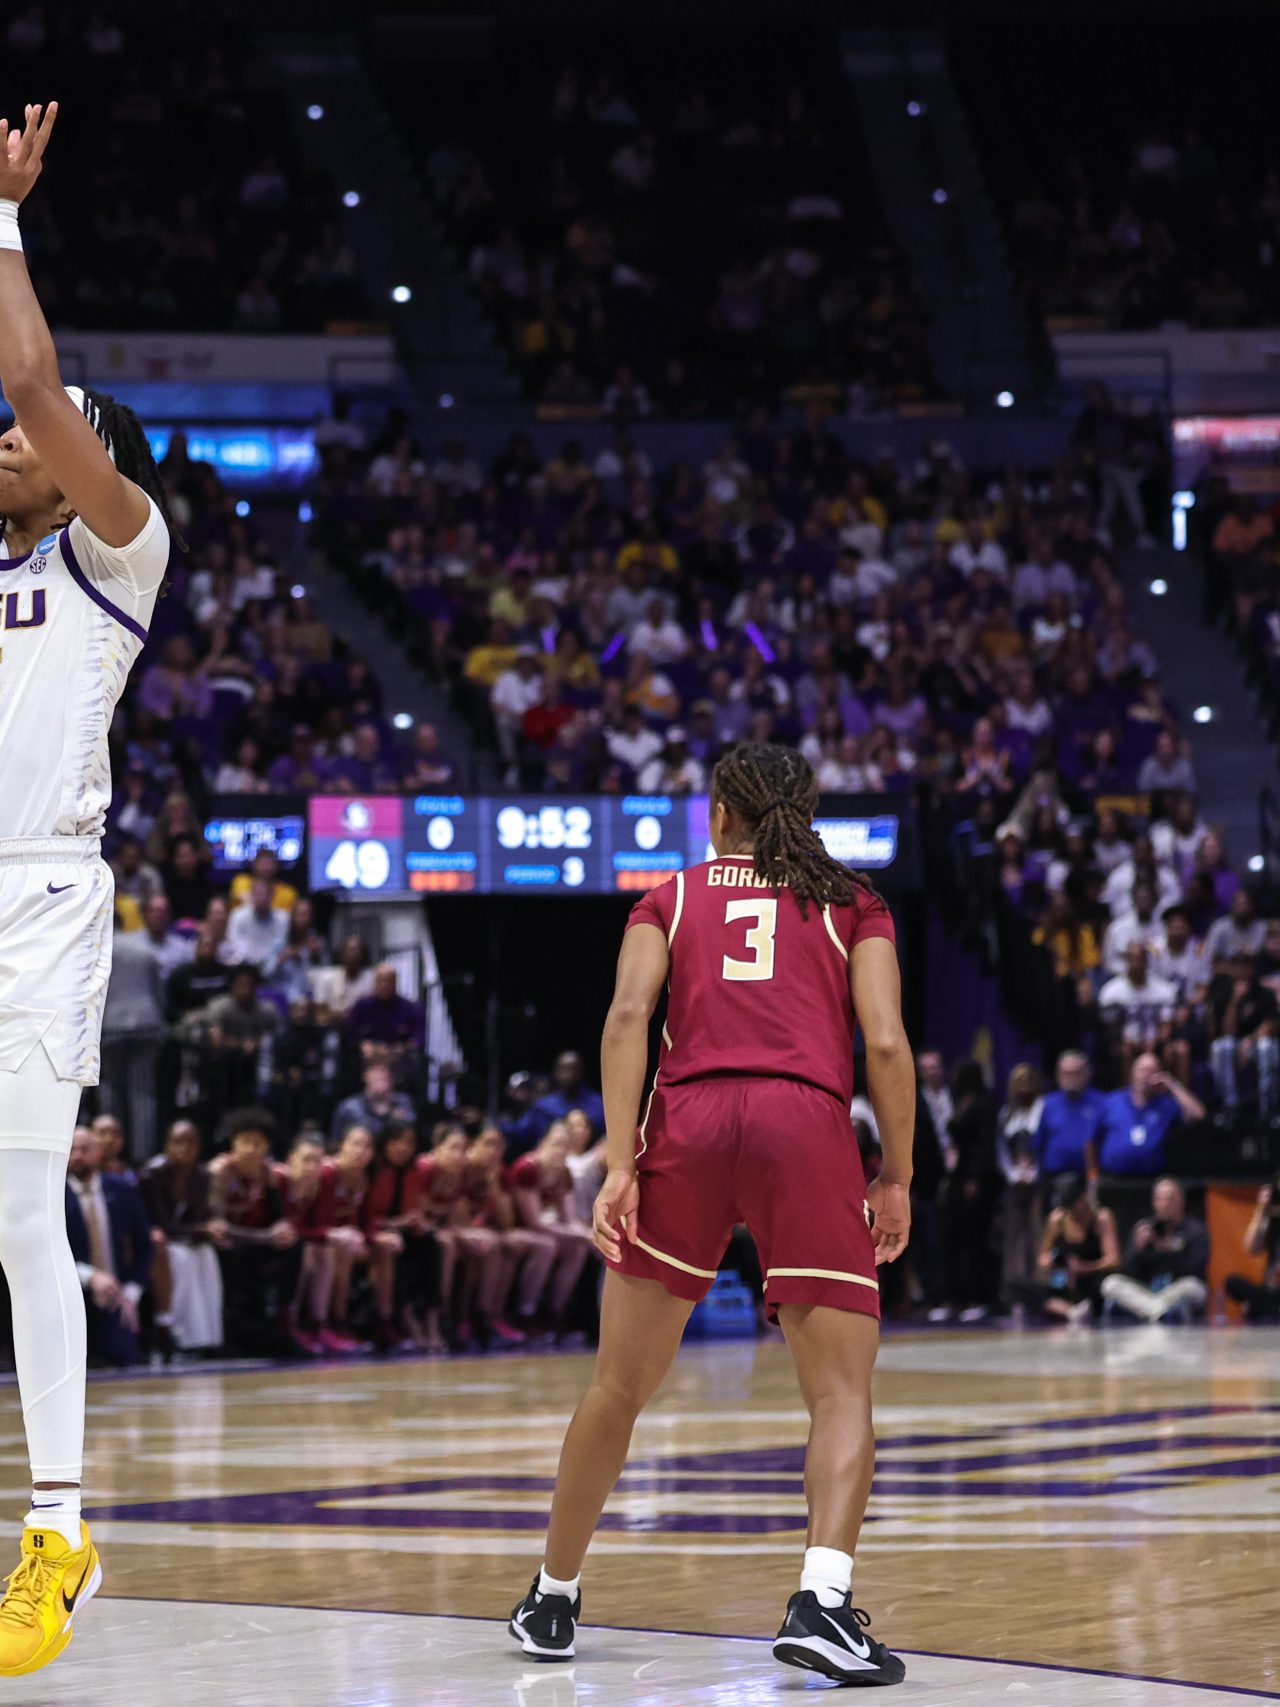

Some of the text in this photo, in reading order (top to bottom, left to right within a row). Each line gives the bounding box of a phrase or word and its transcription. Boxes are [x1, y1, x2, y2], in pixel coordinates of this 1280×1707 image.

[31, 558, 46, 573] SEC
[427, 815, 454, 850] 0
[497, 806, 592, 848] 9:52
[634, 815, 662, 850] 0
[325, 840, 390, 889] 49
[562, 856, 585, 887] 3
[722, 897, 778, 980] 3
